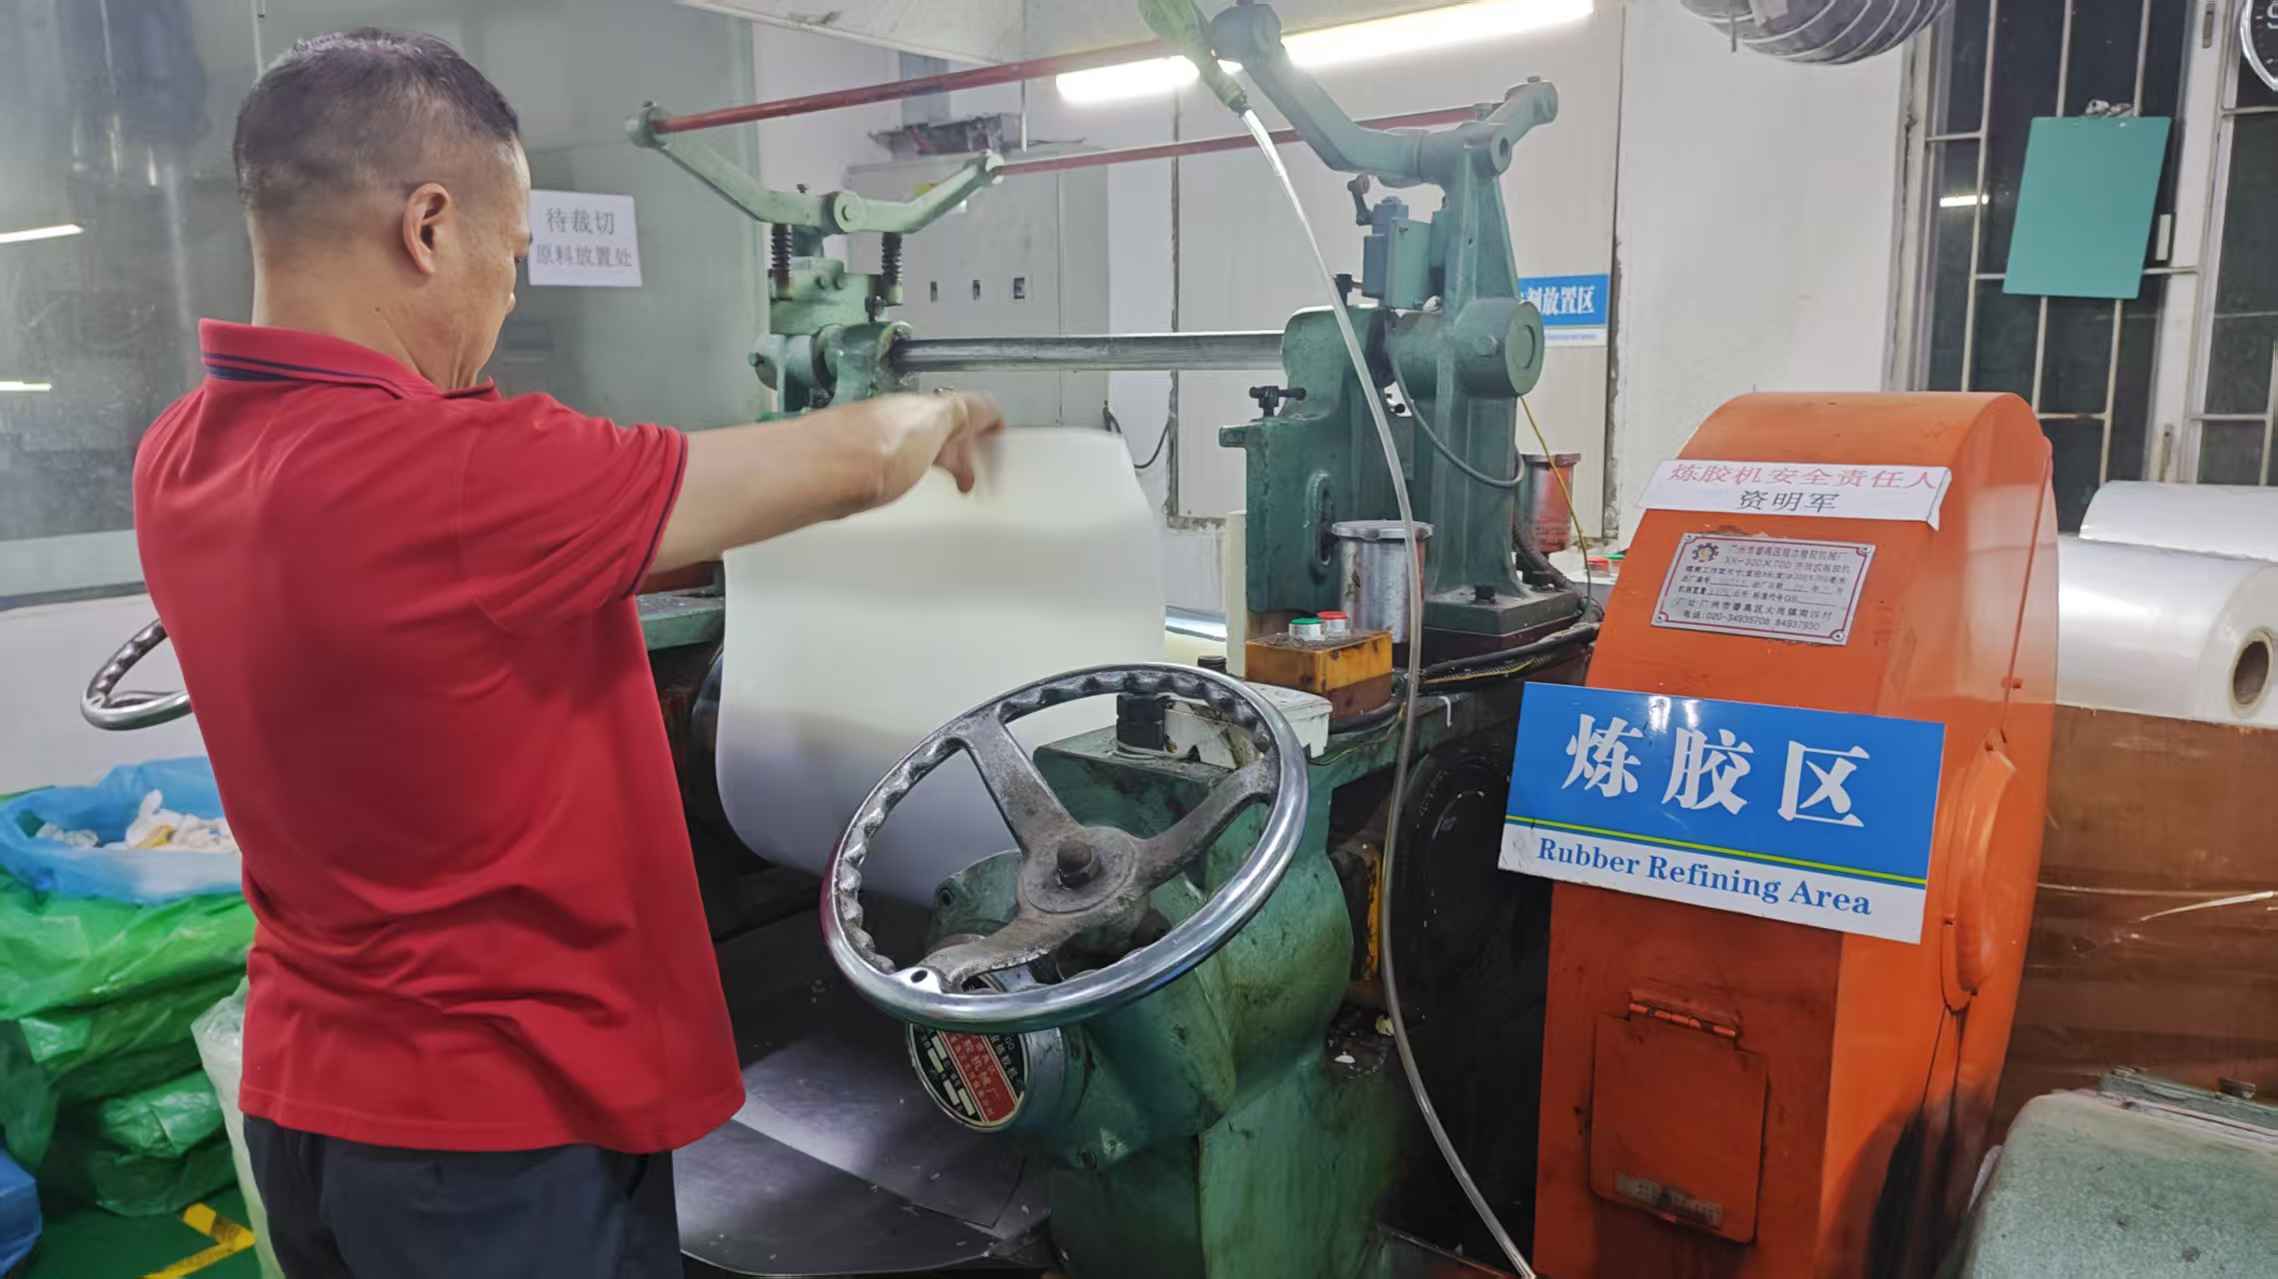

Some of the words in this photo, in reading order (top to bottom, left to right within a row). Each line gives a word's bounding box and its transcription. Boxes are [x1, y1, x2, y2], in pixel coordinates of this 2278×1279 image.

[546, 207, 615, 236] 待裁切
[536, 244, 633, 268] 原料放置处
[1667, 463, 1938, 490] 炼胶机安全责任人
[1739, 489, 1840, 513] 资明军
[1561, 712, 1871, 828] 炼胶区
[1537, 836, 1640, 877] Rubber
[1647, 854, 1782, 904] Refining
[1788, 878, 1872, 917] Area
